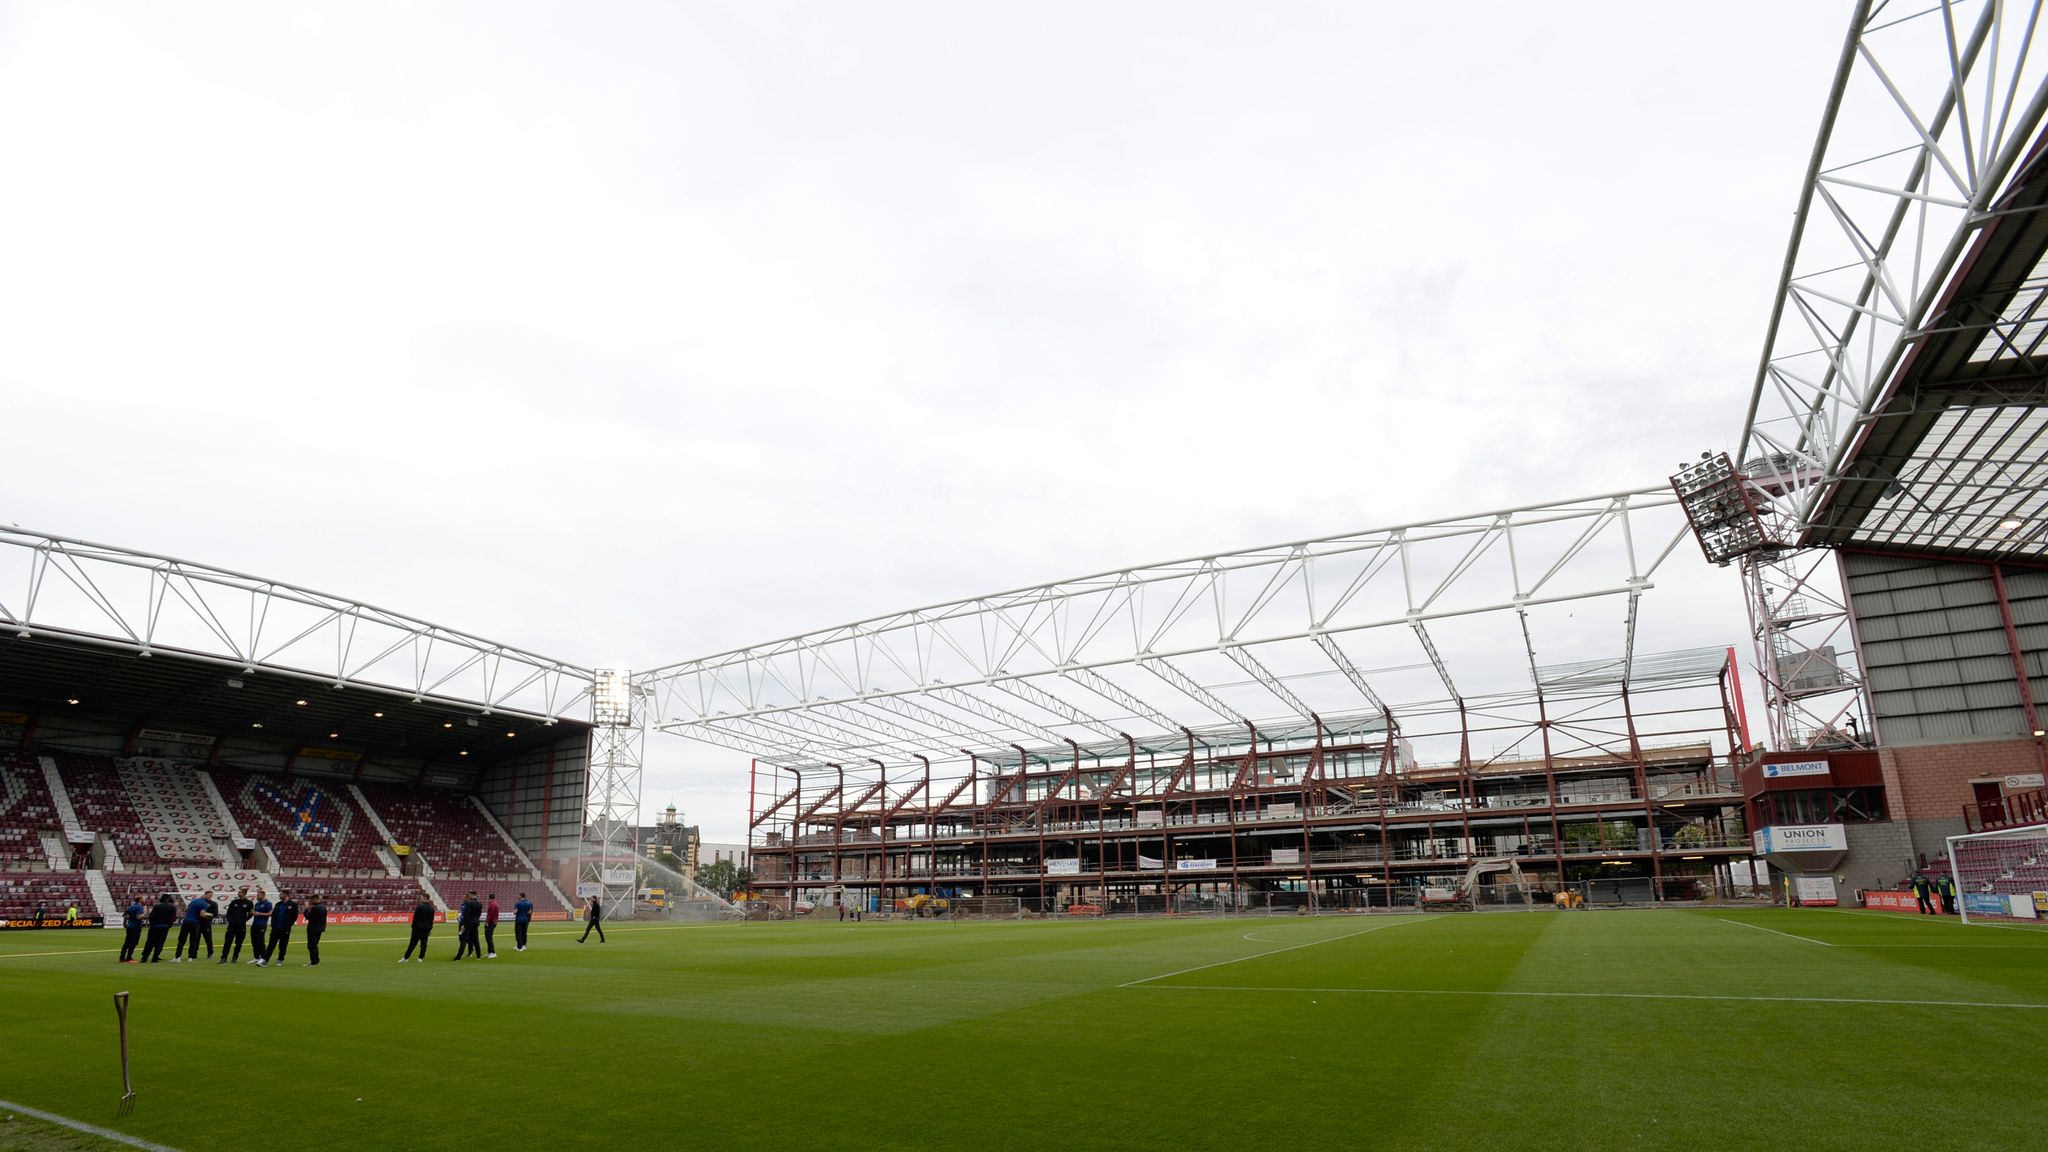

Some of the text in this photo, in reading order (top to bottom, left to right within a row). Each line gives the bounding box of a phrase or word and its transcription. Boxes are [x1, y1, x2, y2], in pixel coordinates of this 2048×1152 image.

[1781, 763, 1822, 772] BELMONT
[1784, 829, 1825, 839] UNION
[609, 871, 633, 880] Murray
